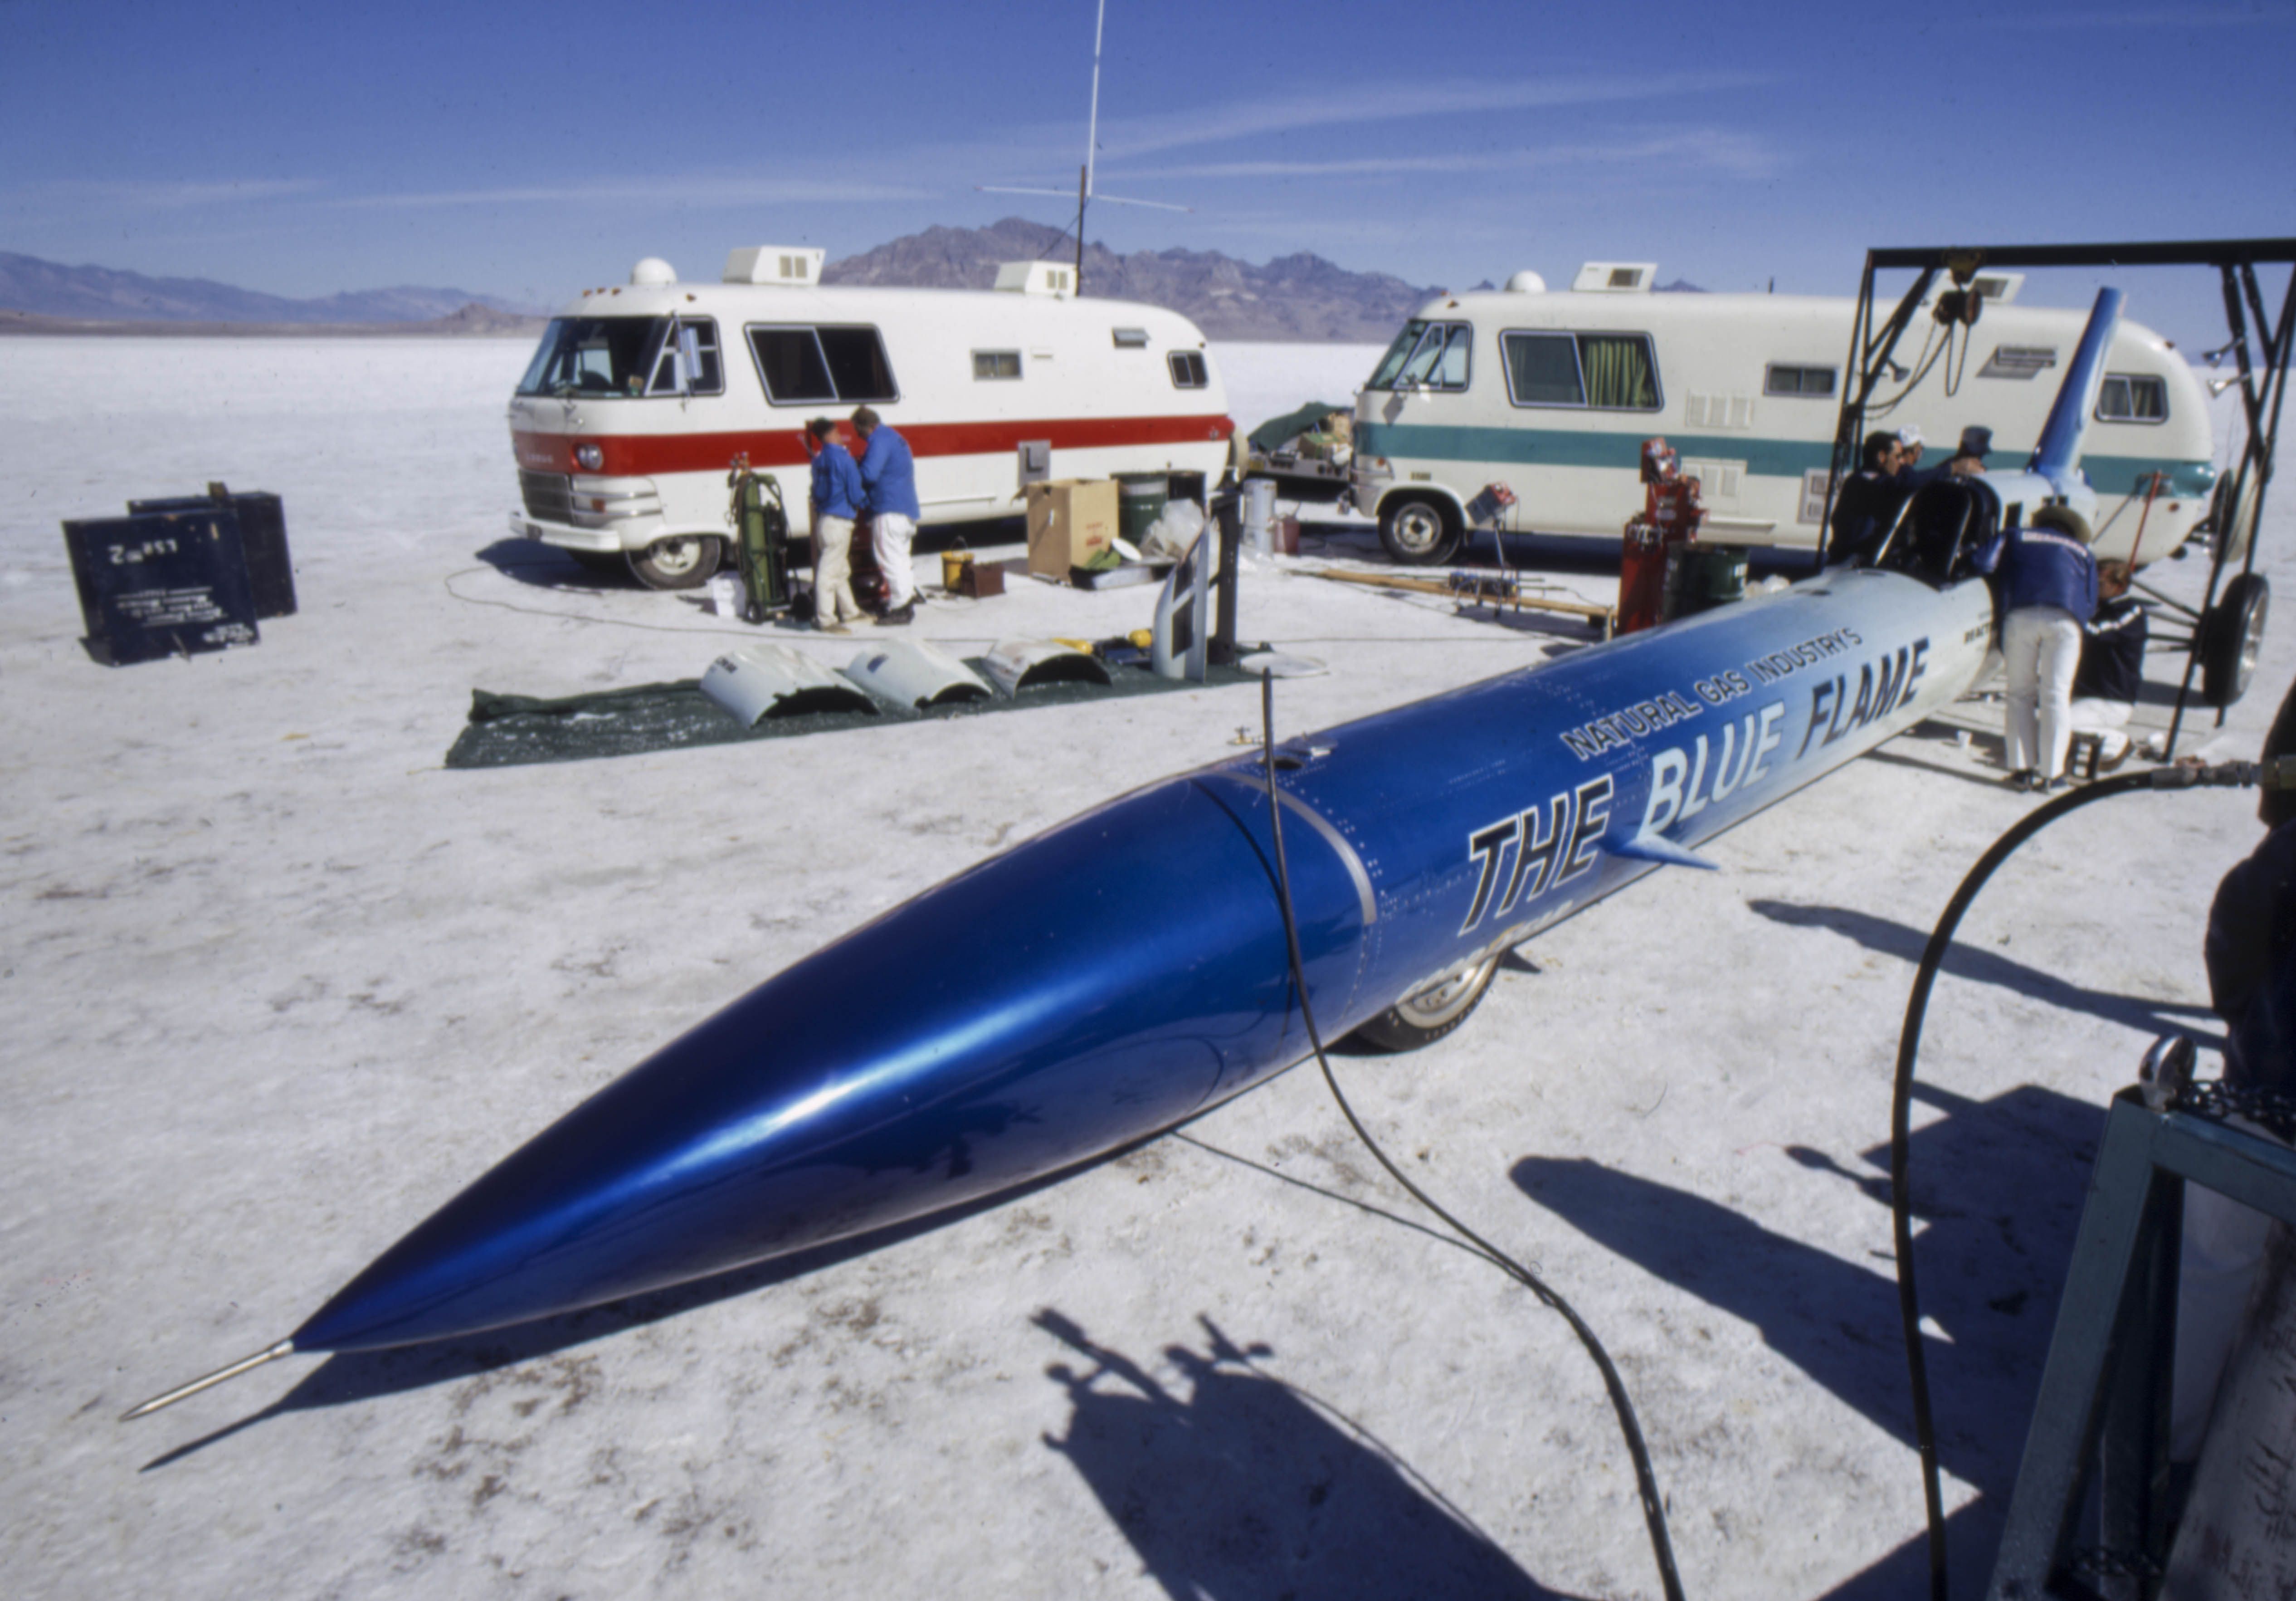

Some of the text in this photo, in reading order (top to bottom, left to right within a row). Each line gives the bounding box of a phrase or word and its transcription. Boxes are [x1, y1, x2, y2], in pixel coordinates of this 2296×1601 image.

[1458, 636, 1929, 937] THE BLUE FLAME
[1559, 628, 1862, 761] NATURAL GAS INDUSTRY'S
